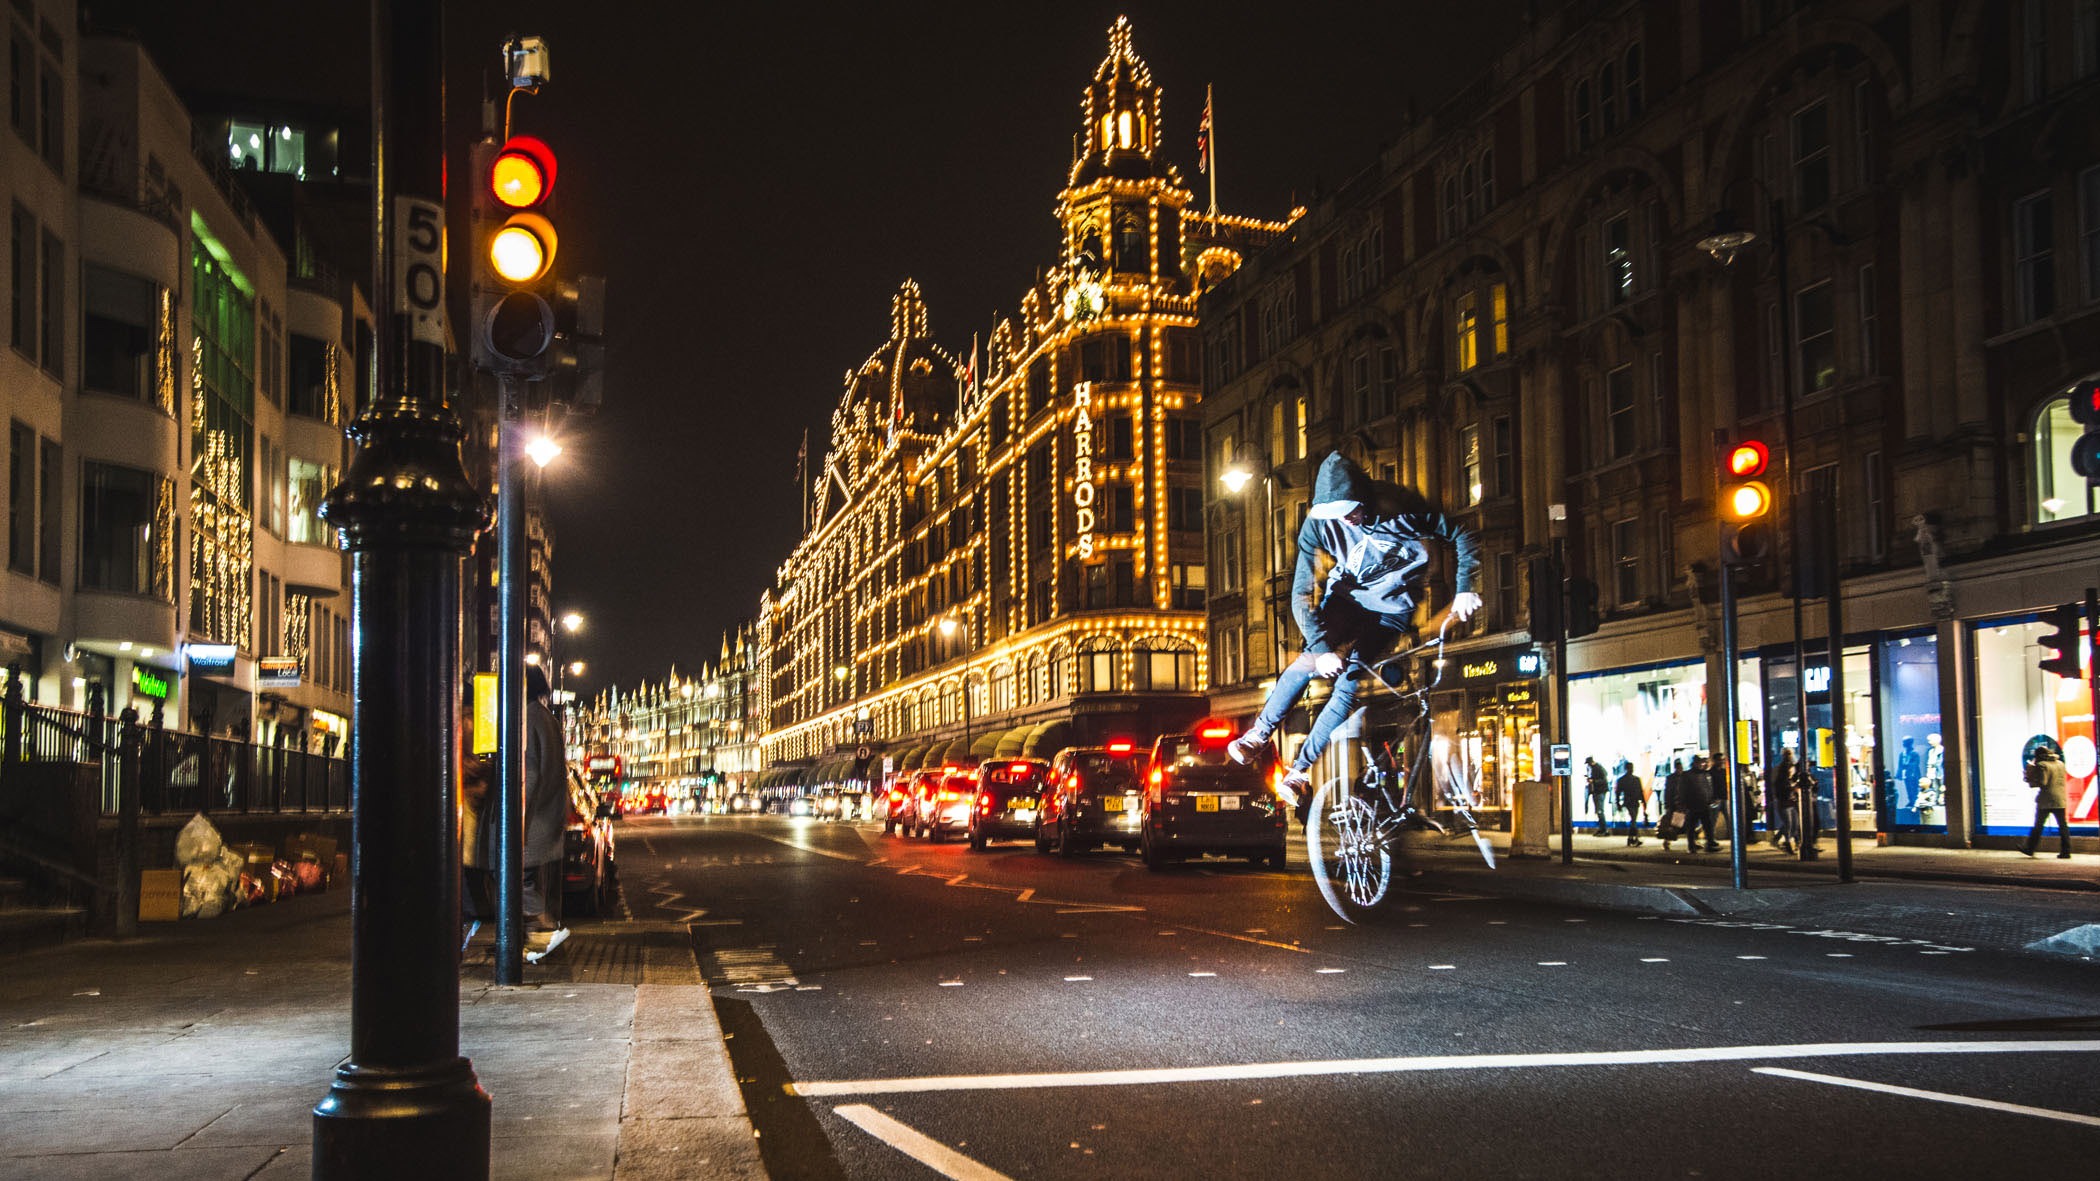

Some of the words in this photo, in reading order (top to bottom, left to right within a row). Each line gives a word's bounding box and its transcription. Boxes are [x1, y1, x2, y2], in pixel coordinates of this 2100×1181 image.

[406, 205, 441, 311] 50
[1073, 380, 1095, 560] HARRODS
[193, 656, 229, 667] Waitrose
[277, 668, 298, 678] Local
[139, 671, 168, 699] Waitrose
[1804, 666, 1830, 692] GAP
